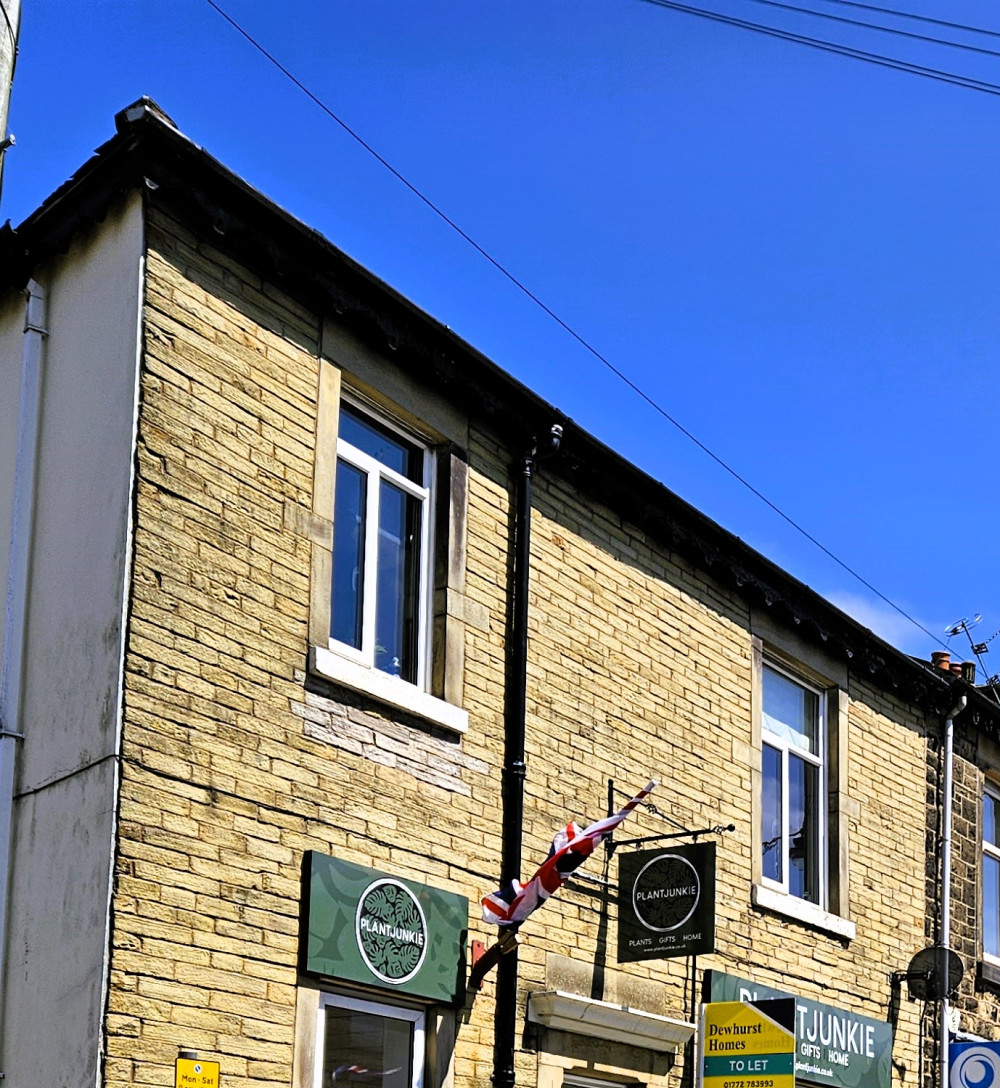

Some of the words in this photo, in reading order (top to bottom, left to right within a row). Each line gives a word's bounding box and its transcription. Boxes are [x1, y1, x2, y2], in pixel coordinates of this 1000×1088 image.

[636, 885, 697, 901] PLANTJUNKIE
[360, 917, 424, 945] PLANTJUNKIE
[629, 938, 652, 947] PLANTS
[658, 935, 676, 944] GIFTS
[683, 932, 702, 941] HOME
[709, 1022, 762, 1036] Dewhurst
[709, 1038, 746, 1051] Homes
[801, 1044, 821, 1060] GIFTS
[828, 1051, 849, 1067] HOME
[729, 1060, 745, 1072] TO
[747, 1059, 769, 1071] LET
[181, 1075, 197, 1083] Mon
[723, 1080, 745, 1088] 01772
[746, 1079, 774, 1088] 783993
